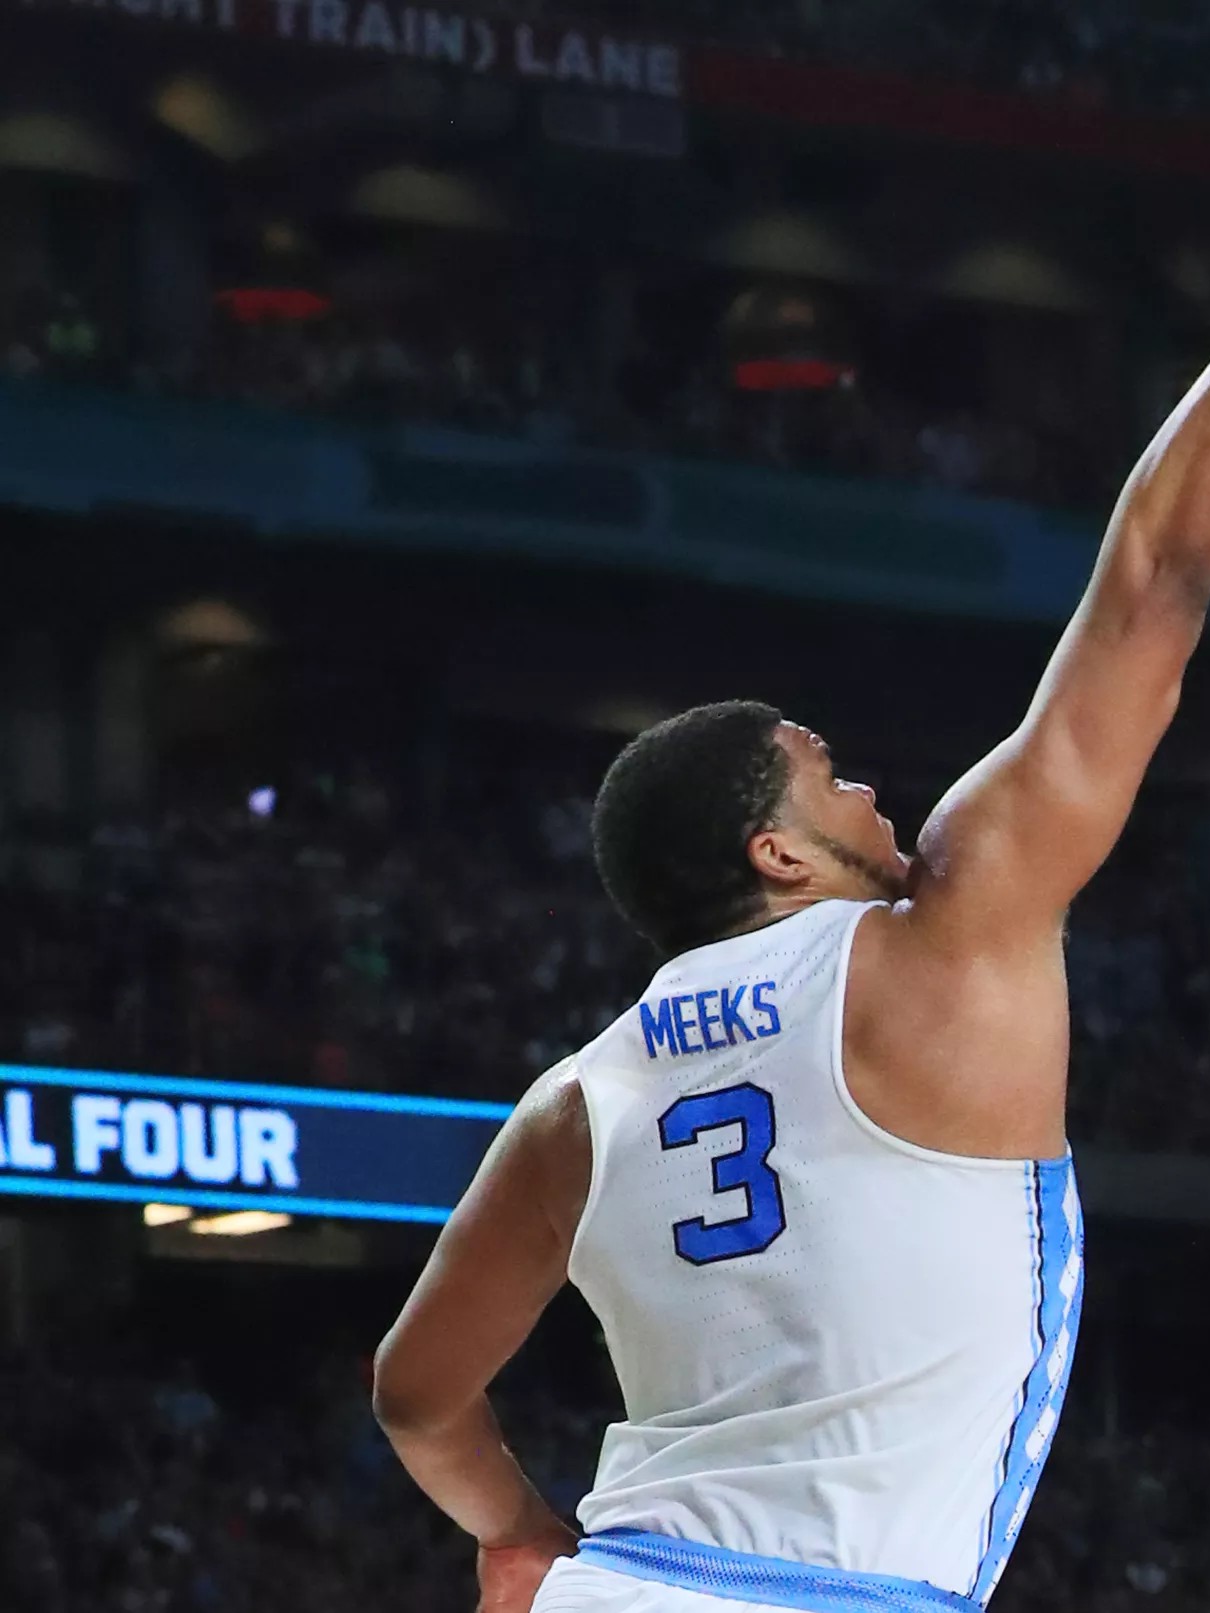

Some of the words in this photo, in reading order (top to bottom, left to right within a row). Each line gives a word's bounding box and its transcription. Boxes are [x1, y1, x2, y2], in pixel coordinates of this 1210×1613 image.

[514, 22, 682, 98] LANE
[639, 980, 782, 1059] MEEKS
[72, 1093, 299, 1188] FOUR
[657, 1081, 787, 1267] 3
